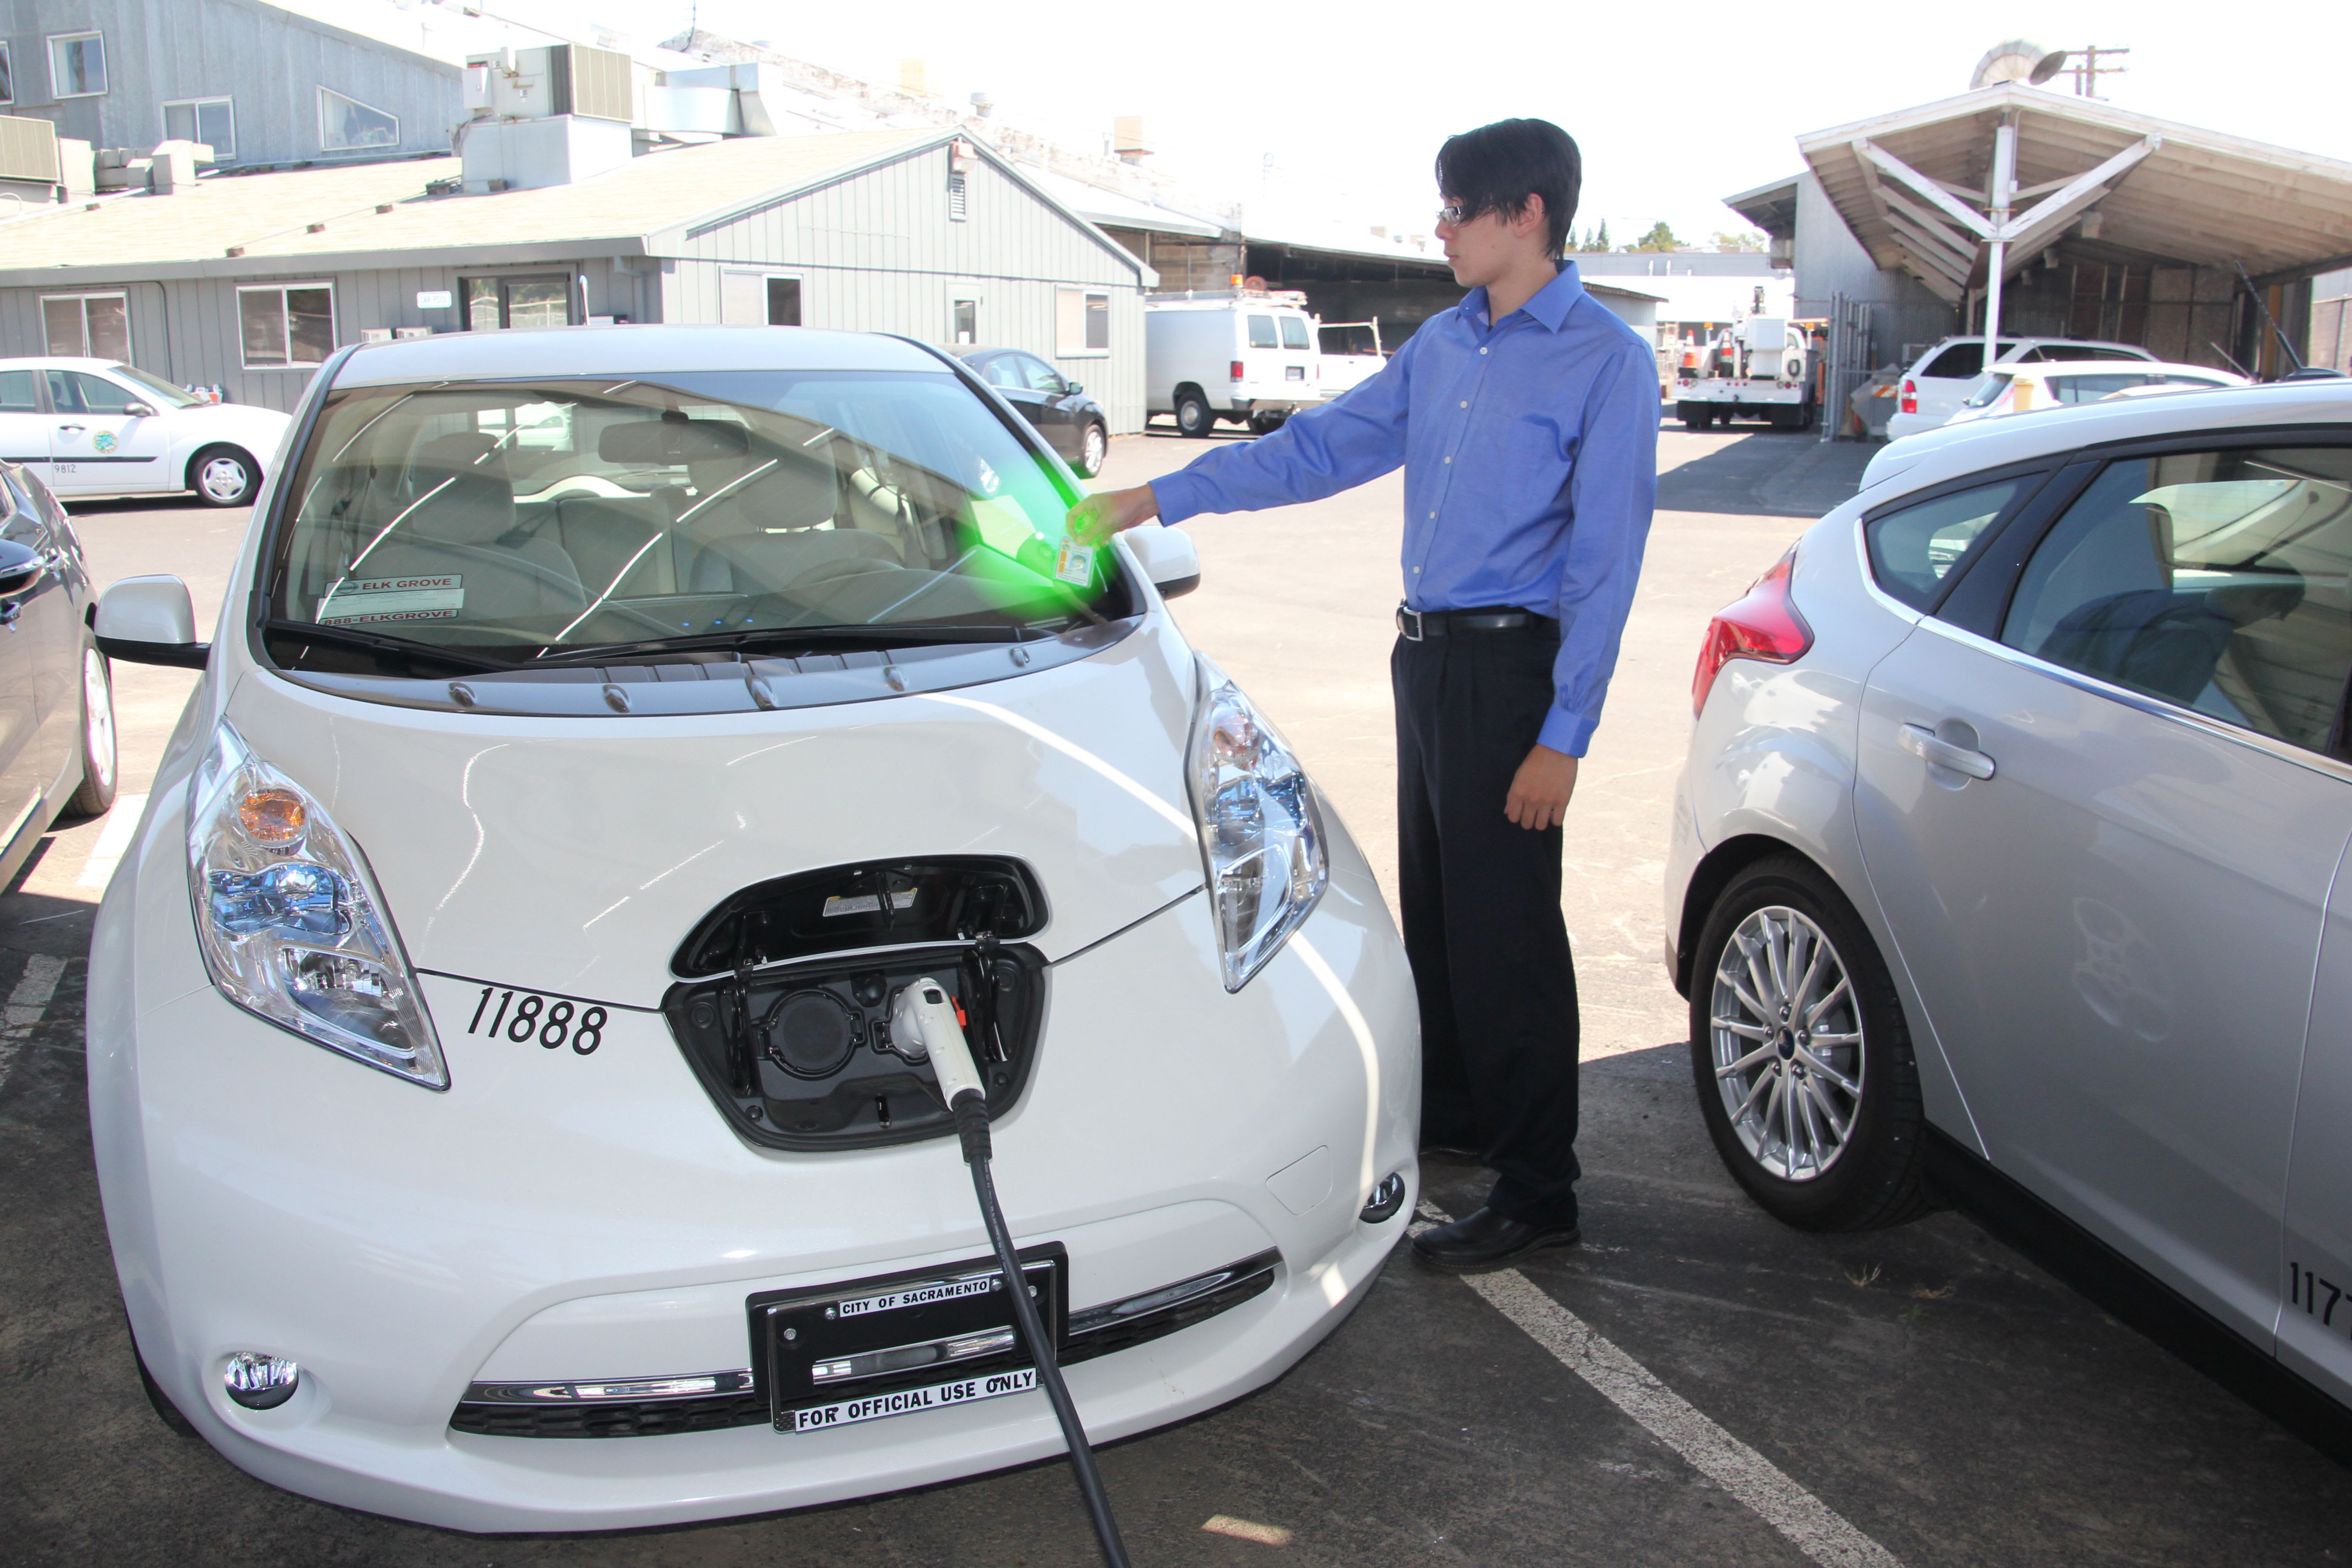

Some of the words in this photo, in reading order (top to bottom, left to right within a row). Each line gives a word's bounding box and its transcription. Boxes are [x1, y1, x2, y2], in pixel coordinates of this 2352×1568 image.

[420, 295, 431, 304] CAR
[433, 295, 448, 304] POOL
[54, 464, 76, 473] 9812
[363, 582, 392, 590] ELK
[397, 578, 451, 588] GROVE
[324, 611, 453, 625] 888-ELKGROVE
[468, 987, 608, 1055] 11888
[843, 1301, 870, 1314] CITY
[878, 1297, 896, 1308] OF
[903, 1281, 987, 1304] SACRAMENTO
[2290, 1262, 2352, 1341] 117
[799, 1407, 837, 1427] FOR
[848, 1390, 932, 1418] OFFICIAL
[941, 1382, 975, 1401] USE
[986, 1372, 1033, 1393] ONLY
